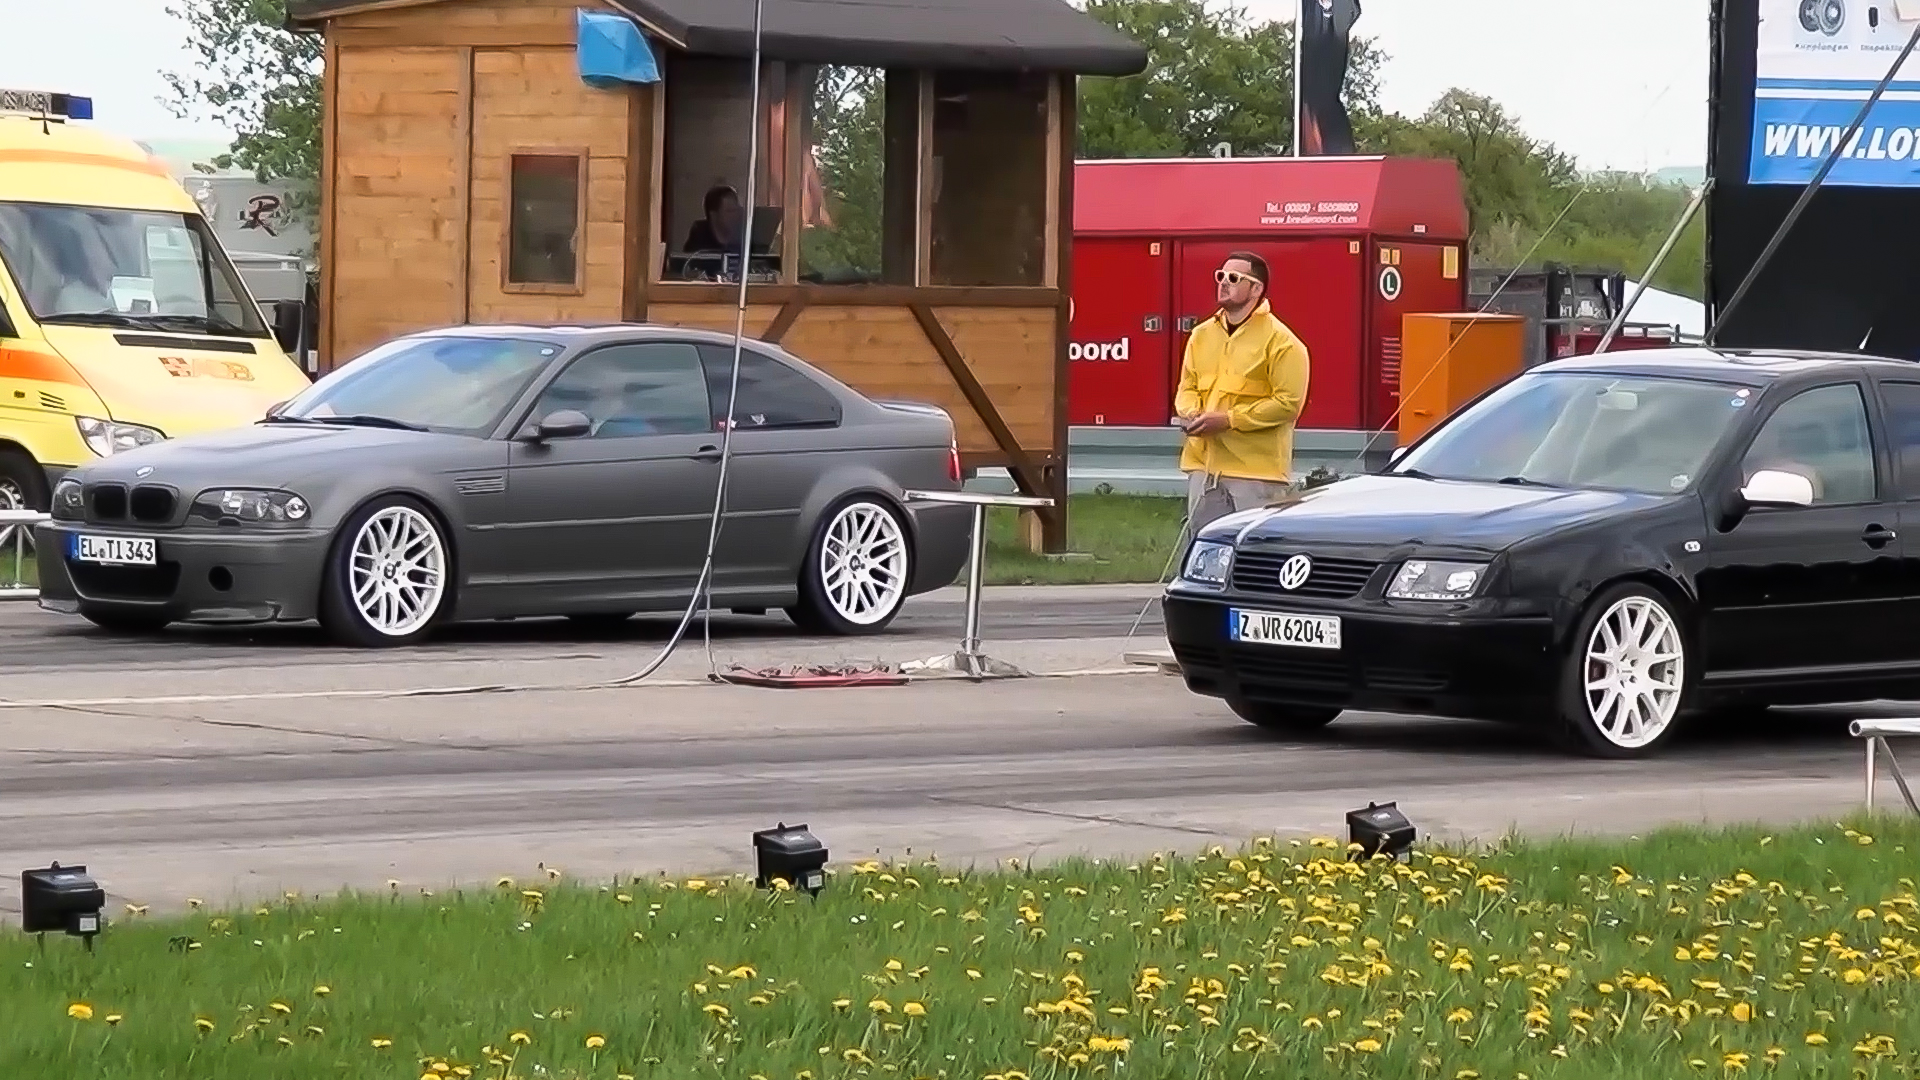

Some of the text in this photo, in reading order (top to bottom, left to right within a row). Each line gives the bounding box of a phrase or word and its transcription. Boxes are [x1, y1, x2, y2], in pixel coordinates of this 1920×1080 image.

[1068, 337, 1129, 361] oord
[80, 537, 97, 558] EL
[1240, 614, 1250, 638] Z
